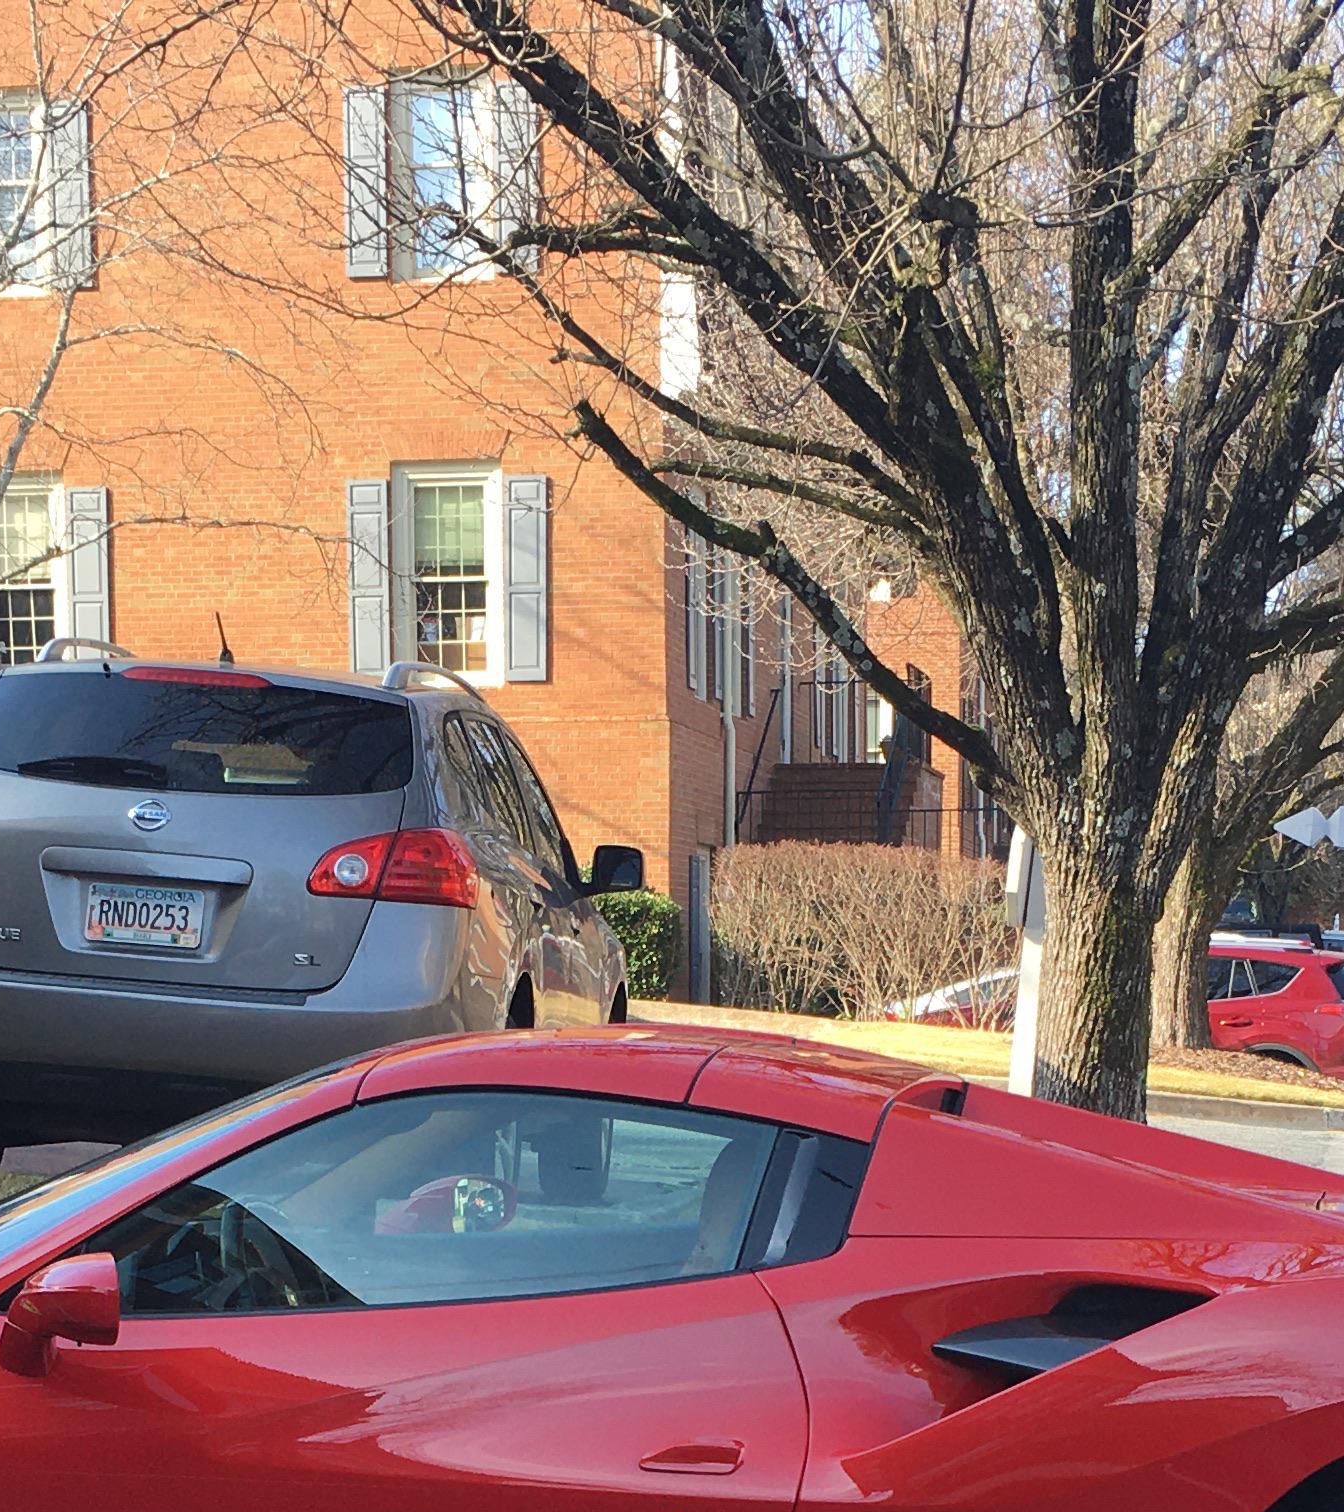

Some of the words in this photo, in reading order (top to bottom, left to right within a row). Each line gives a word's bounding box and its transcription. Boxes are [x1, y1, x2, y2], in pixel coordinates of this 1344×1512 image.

[135, 888, 196, 903] GEORGIA
[98, 899, 190, 932] RND0253
[294, 953, 321, 967] SL
